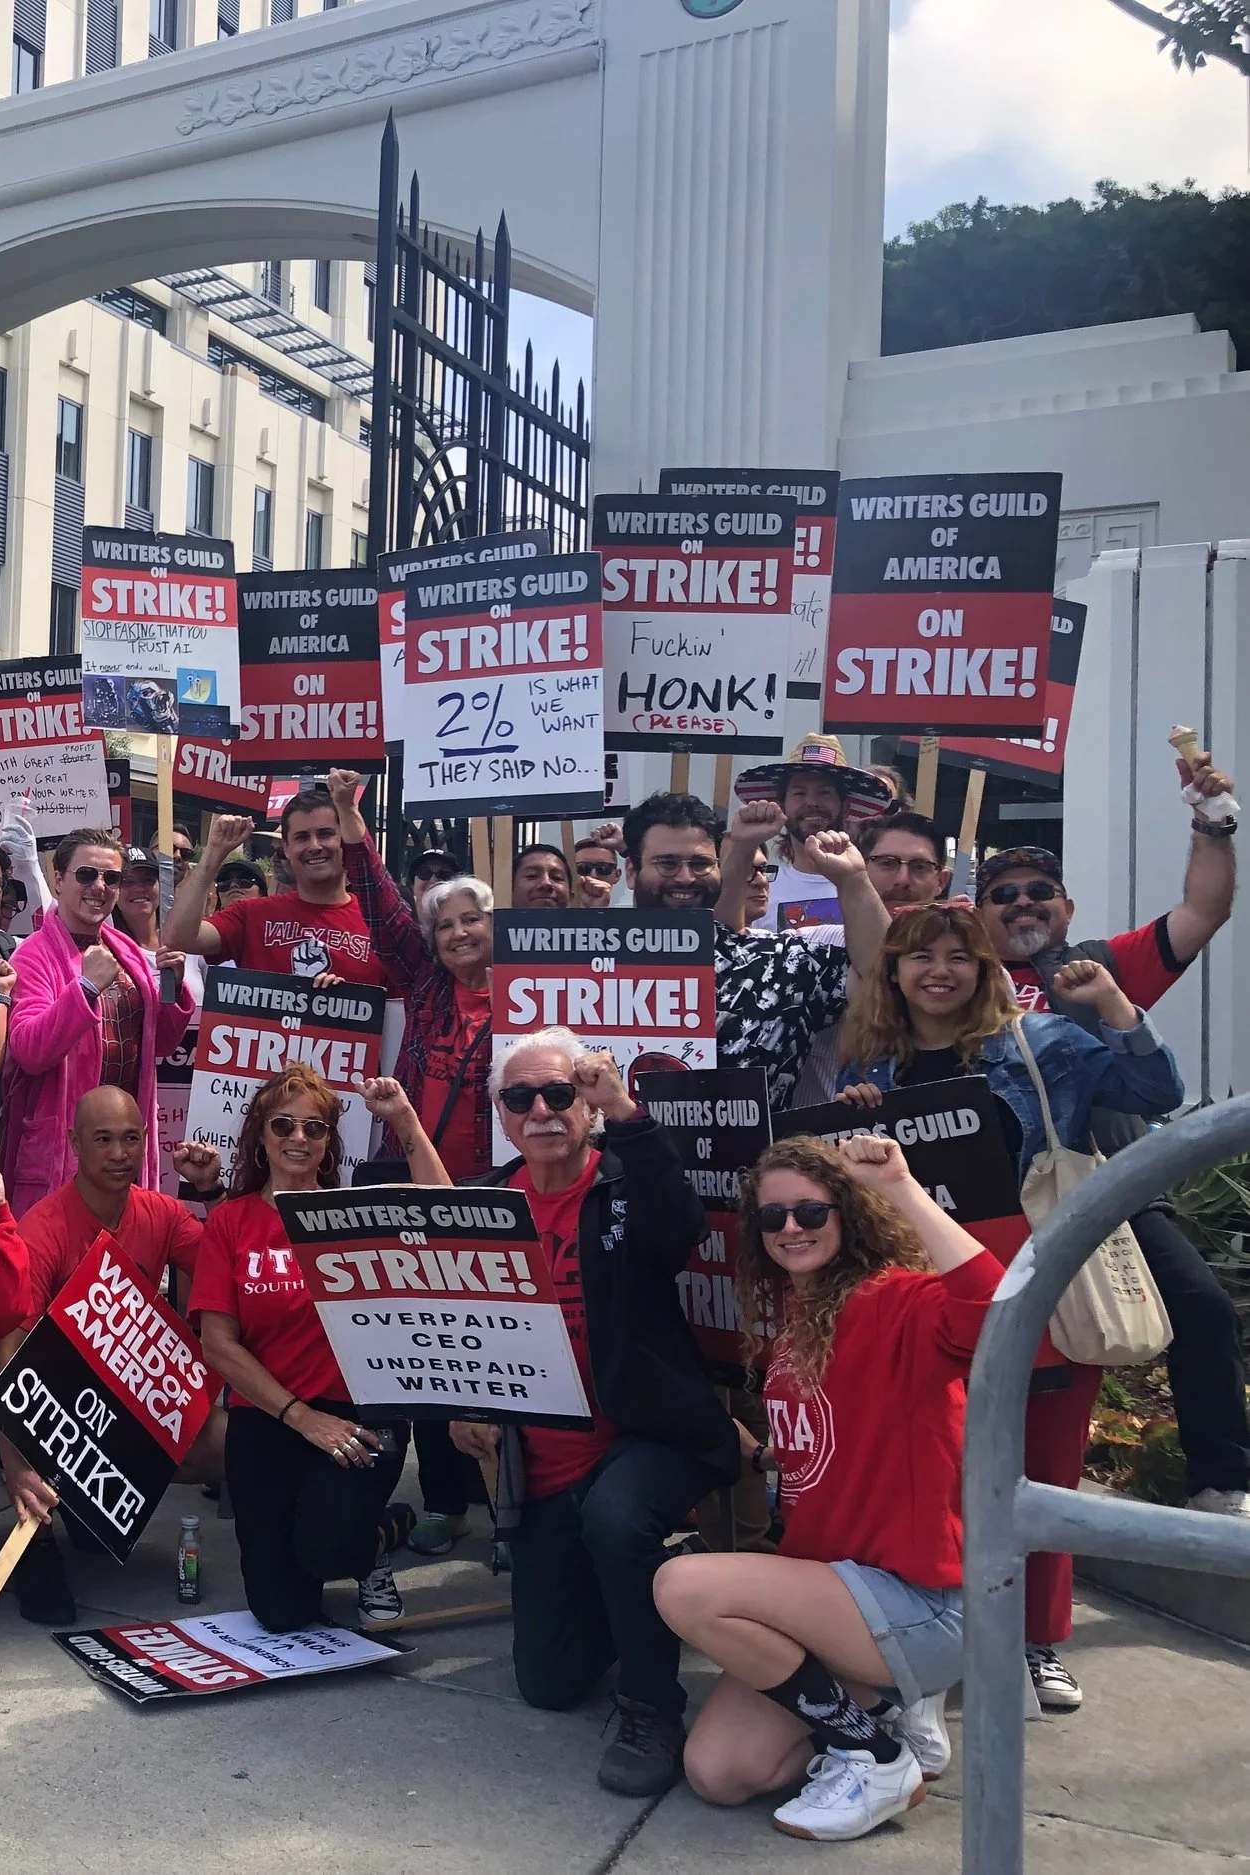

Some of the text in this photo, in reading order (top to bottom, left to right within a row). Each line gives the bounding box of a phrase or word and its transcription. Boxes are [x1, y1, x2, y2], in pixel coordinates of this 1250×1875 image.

[851, 493, 1047, 521] WRITERS GUILD
[607, 512, 782, 535] WRITERS GUILD
[681, 540, 703, 554] ON
[931, 528, 959, 546] OF
[92, 540, 224, 569] WRITERS GUILD
[151, 567, 168, 578] ON
[883, 556, 1001, 581] AMERICA
[418, 570, 588, 608] WRITERS GUILD
[603, 559, 779, 606] STRIKE!
[92, 578, 226, 622] STRIKE!
[243, 588, 378, 610] WRITERS GUILD
[300, 614, 318, 629] OF
[490, 604, 511, 619] ON
[84, 620, 207, 640] STOP FAKING THAT YOU
[918, 609, 964, 637] ON
[128, 641, 170, 653] TRUST
[269, 635, 349, 654] AMERICA
[417, 615, 589, 674] STRIKE!
[835, 647, 1038, 698] STRIKE!
[293, 675, 325, 696] ON
[529, 675, 599, 696] IS WHAT
[618, 672, 777, 720] HONK!
[27, 692, 41, 703] ON
[531, 698, 564, 715] WE
[436, 683, 514, 746] 2%
[542, 714, 599, 734] WANT
[633, 714, 738, 736] (PLEASE)
[24, 755, 54, 768] GREAT
[35, 774, 67, 784] GREAT
[419, 759, 482, 788] THEY
[488, 759, 535, 782] SAID
[32, 788, 55, 800] YOUR
[327, 929, 370, 962] EAST
[509, 928, 699, 952] WRITERS GUILD
[591, 958, 614, 972] ON
[217, 982, 372, 1022] WRITERS GUILD
[508, 978, 700, 1028] STRIKE!
[281, 1016, 301, 1030] ON
[716, 1101, 760, 1127] GUILD
[895, 1108, 980, 1146] GUILD
[697, 1138, 712, 1159] OF
[295, 1205, 516, 1232] WRITERS GUILD
[399, 1231, 427, 1245] ON
[315, 1250, 539, 1296] STRIKE!
[244, 1280, 304, 1294] SOUTH
[99, 1250, 207, 1390] WRITERS
[352, 1313, 532, 1331] OVERPAID:
[88, 1282, 192, 1406] GUILD OF
[411, 1333, 483, 1350] CEO
[64, 1299, 183, 1444] AMERICA
[367, 1358, 548, 1379] UNDERPAID:
[395, 1377, 529, 1398] WRITER
[74, 1388, 117, 1438] ON
[1, 1368, 146, 1536] STRIKE
[199, 1621, 224, 1634] PAY
[119, 1627, 249, 1685] STRIKE!
[287, 1635, 337, 1656] DOWN
[68, 1635, 168, 1694] WRITERS GUILD
